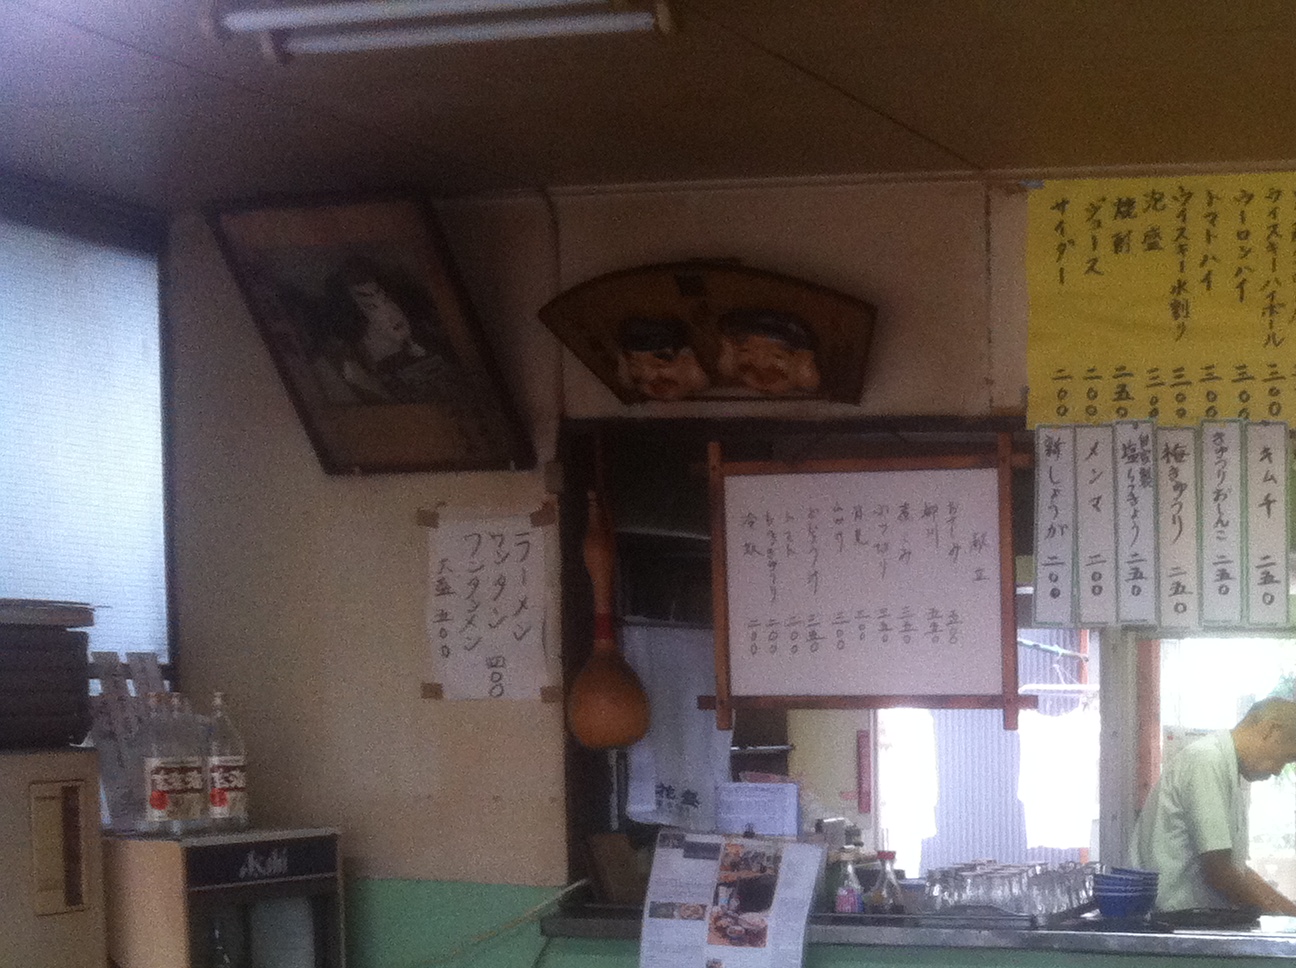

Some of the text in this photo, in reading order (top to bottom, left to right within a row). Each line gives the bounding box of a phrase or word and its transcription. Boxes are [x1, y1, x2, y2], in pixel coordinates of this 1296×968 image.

[1050, 198, 1076, 285] サイダー
[1084, 195, 1107, 276] ジュース
[1199, 190, 1221, 292] トマトハイ
[1233, 189, 1255, 303] ウーロンハイ
[1085, 440, 1103, 513] メンマ
[1161, 442, 1190, 545] 梅きゅうり
[488, 533, 510, 629] ワンタン
[514, 532, 533, 642] ラーメン
